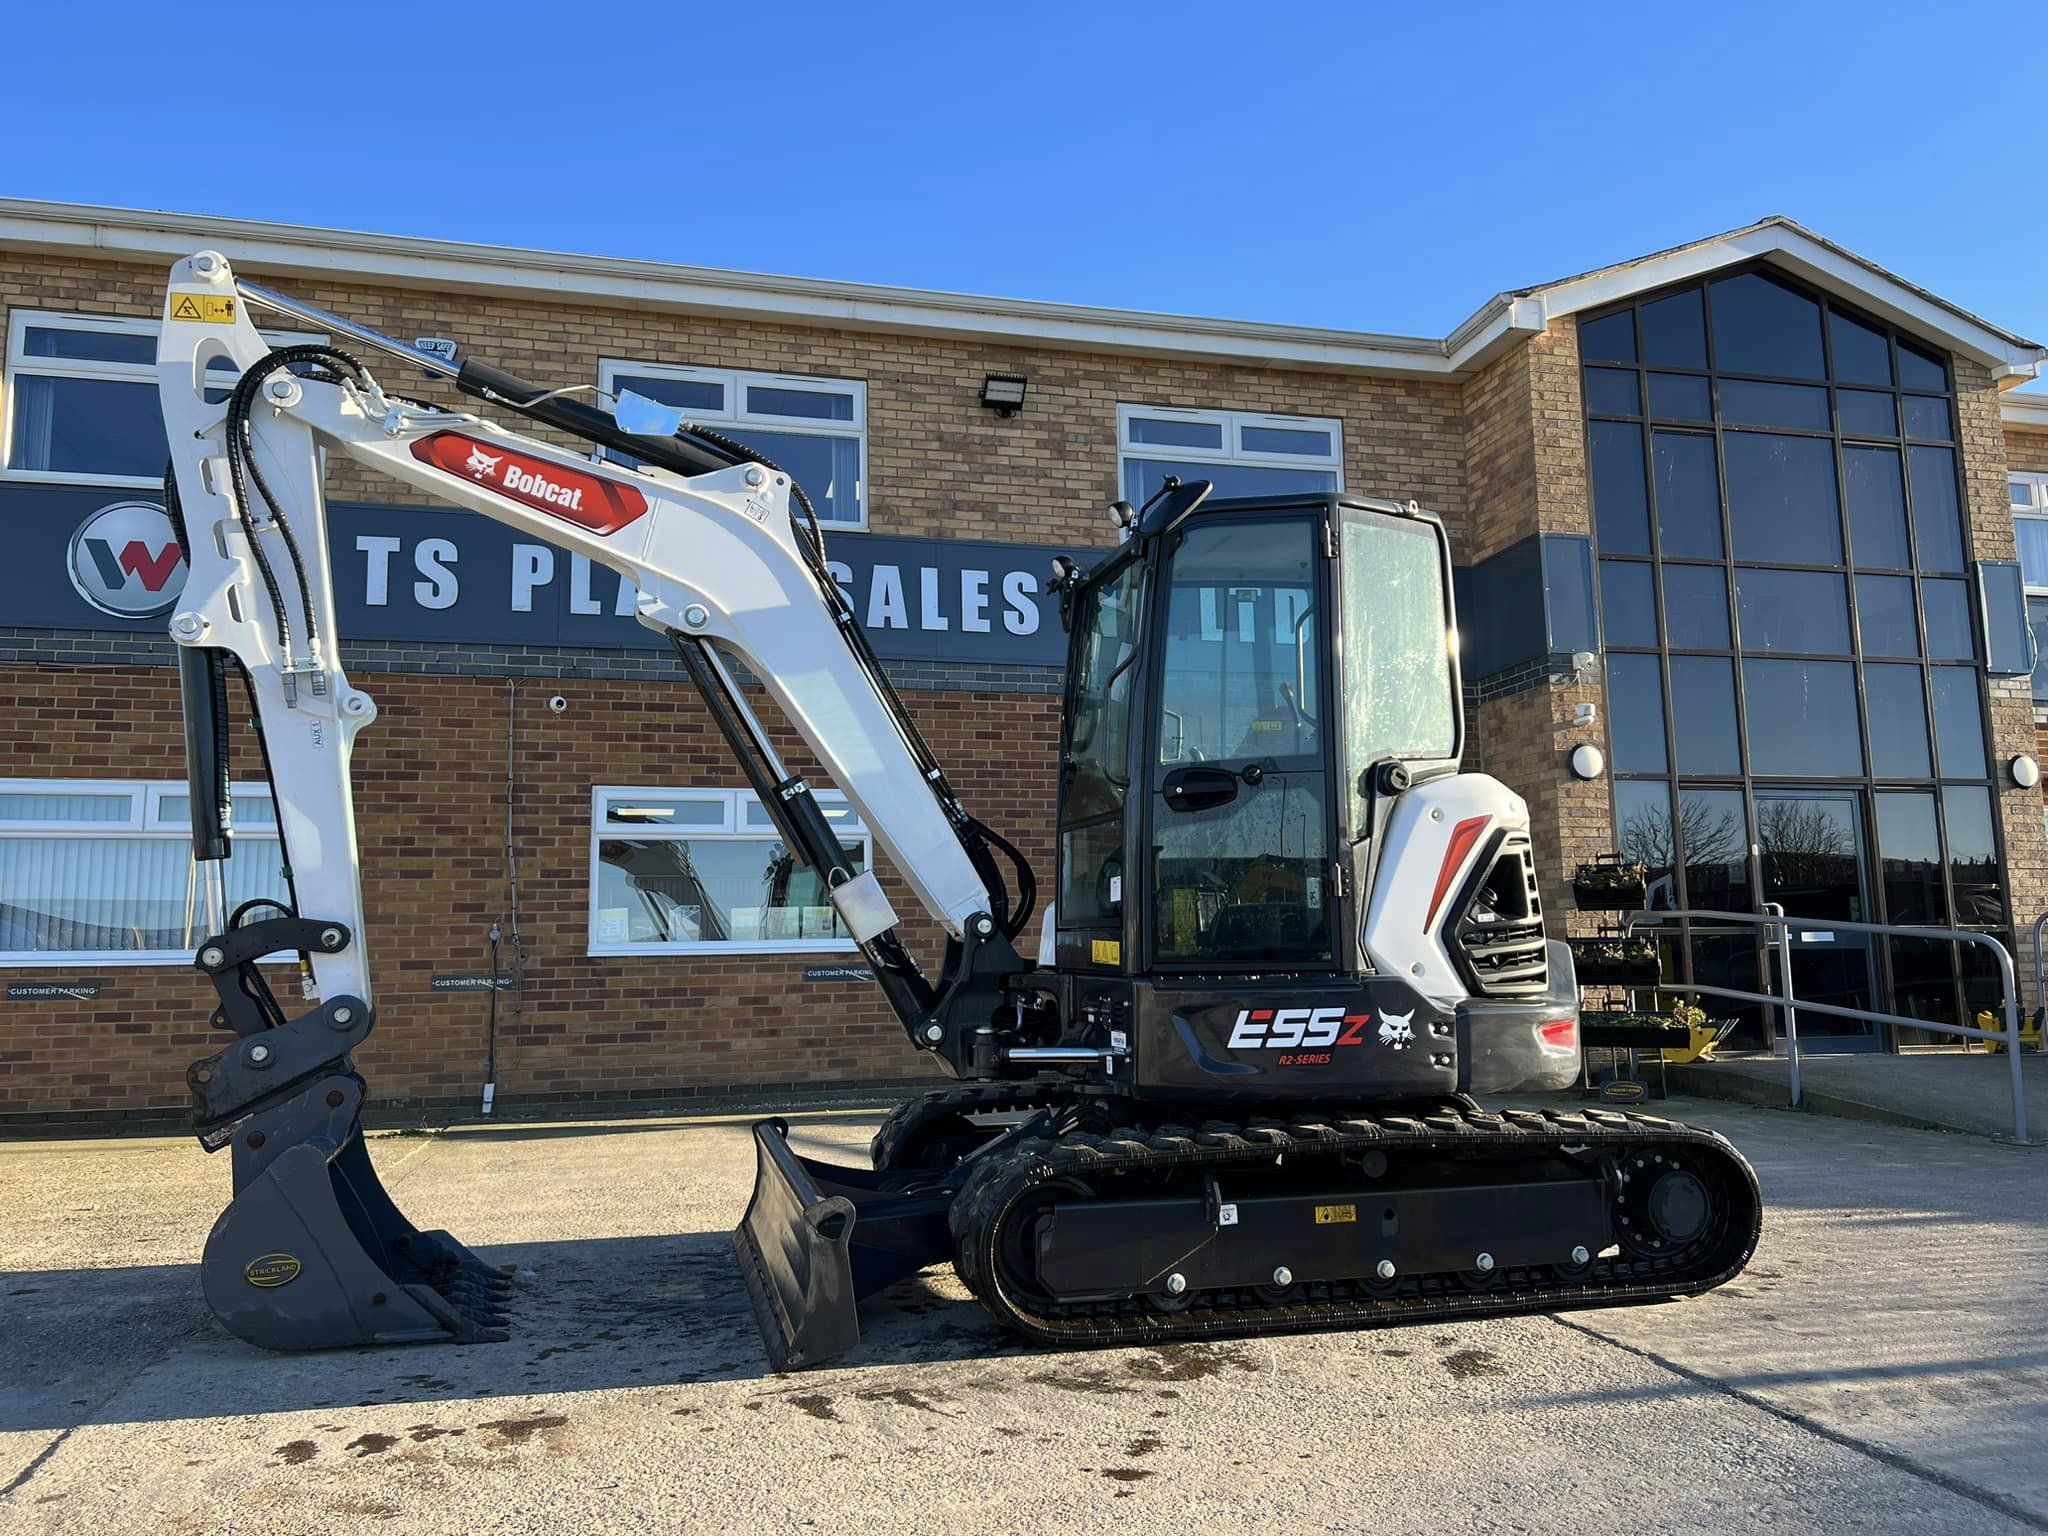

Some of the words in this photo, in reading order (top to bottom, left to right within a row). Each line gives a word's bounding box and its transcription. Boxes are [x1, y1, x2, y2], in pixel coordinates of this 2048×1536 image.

[503, 464, 582, 511] Bobcat
[356, 535, 459, 610] TS
[435, 979, 477, 987] CUSTOMER
[10, 987, 56, 995] CUSTOMER
[58, 987, 95, 995] PARKING
[1279, 1053, 1332, 1065] R2-SERIES
[249, 1263, 297, 1277] STRICKLAND
